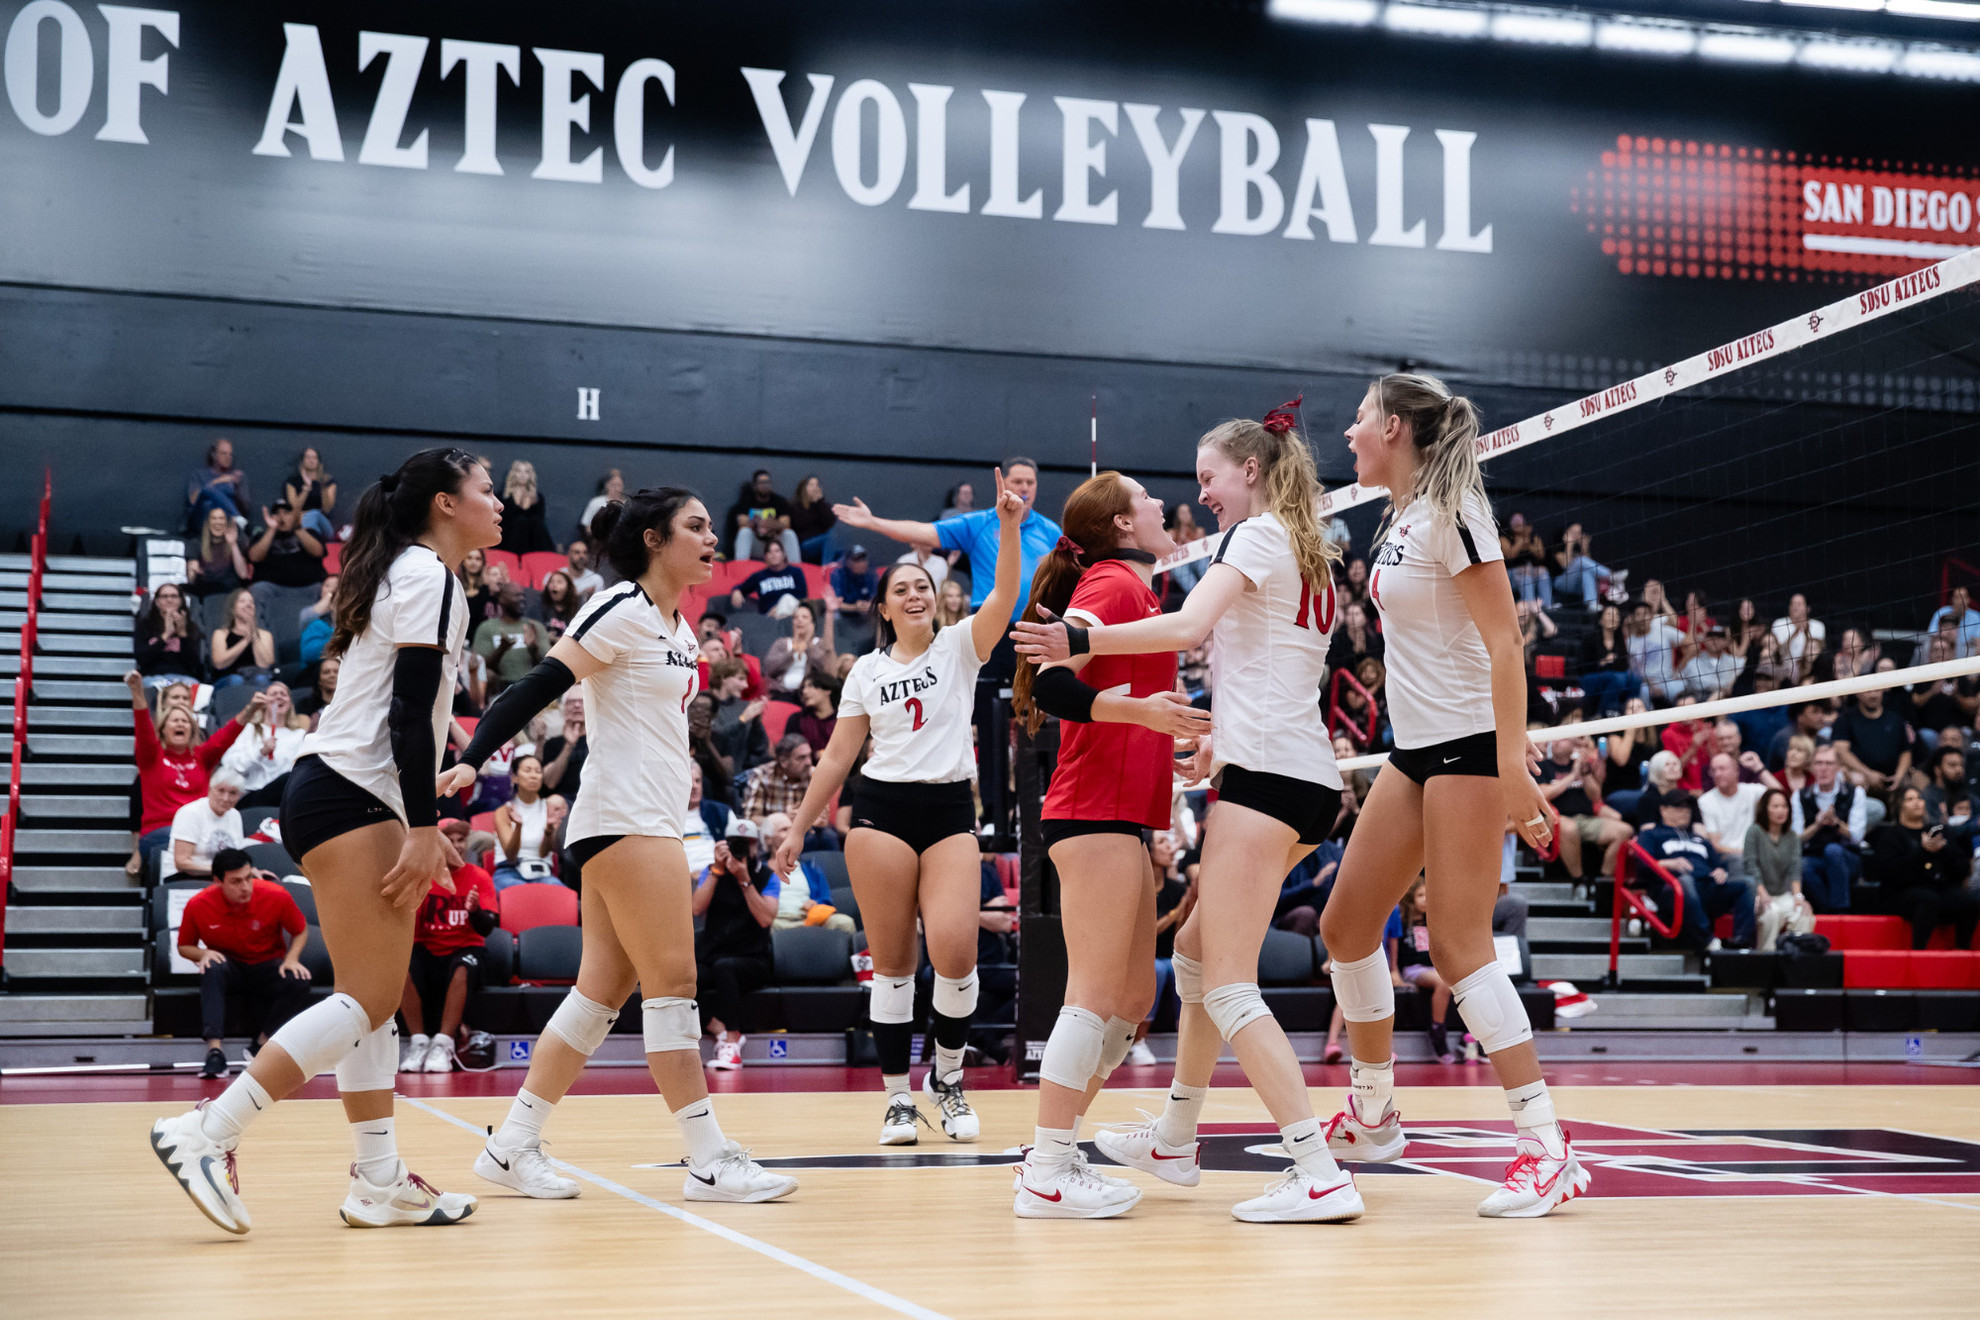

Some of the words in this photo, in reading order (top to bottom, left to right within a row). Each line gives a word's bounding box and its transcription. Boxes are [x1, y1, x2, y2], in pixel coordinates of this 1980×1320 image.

[4, 0, 180, 144] OF
[252, 22, 676, 190] AZTEC
[740, 66, 1493, 253] VOLLEYBALL
[1803, 180, 1863, 224] SAN
[1872, 186, 1972, 233] DIEGO
[1859, 284, 1890, 315] SDSU
[1894, 265, 1941, 303] AZTECS
[1707, 345, 1734, 372] SDSU
[1737, 329, 1775, 361] AZTECS
[577, 388, 600, 421] H
[1579, 394, 1601, 418] SDSU
[1604, 381, 1637, 410] AZTECS
[1475, 436, 1490, 455] DSU
[1294, 572, 1335, 635] 10
[904, 697, 929, 732] 2
[448, 909, 469, 926] UP
